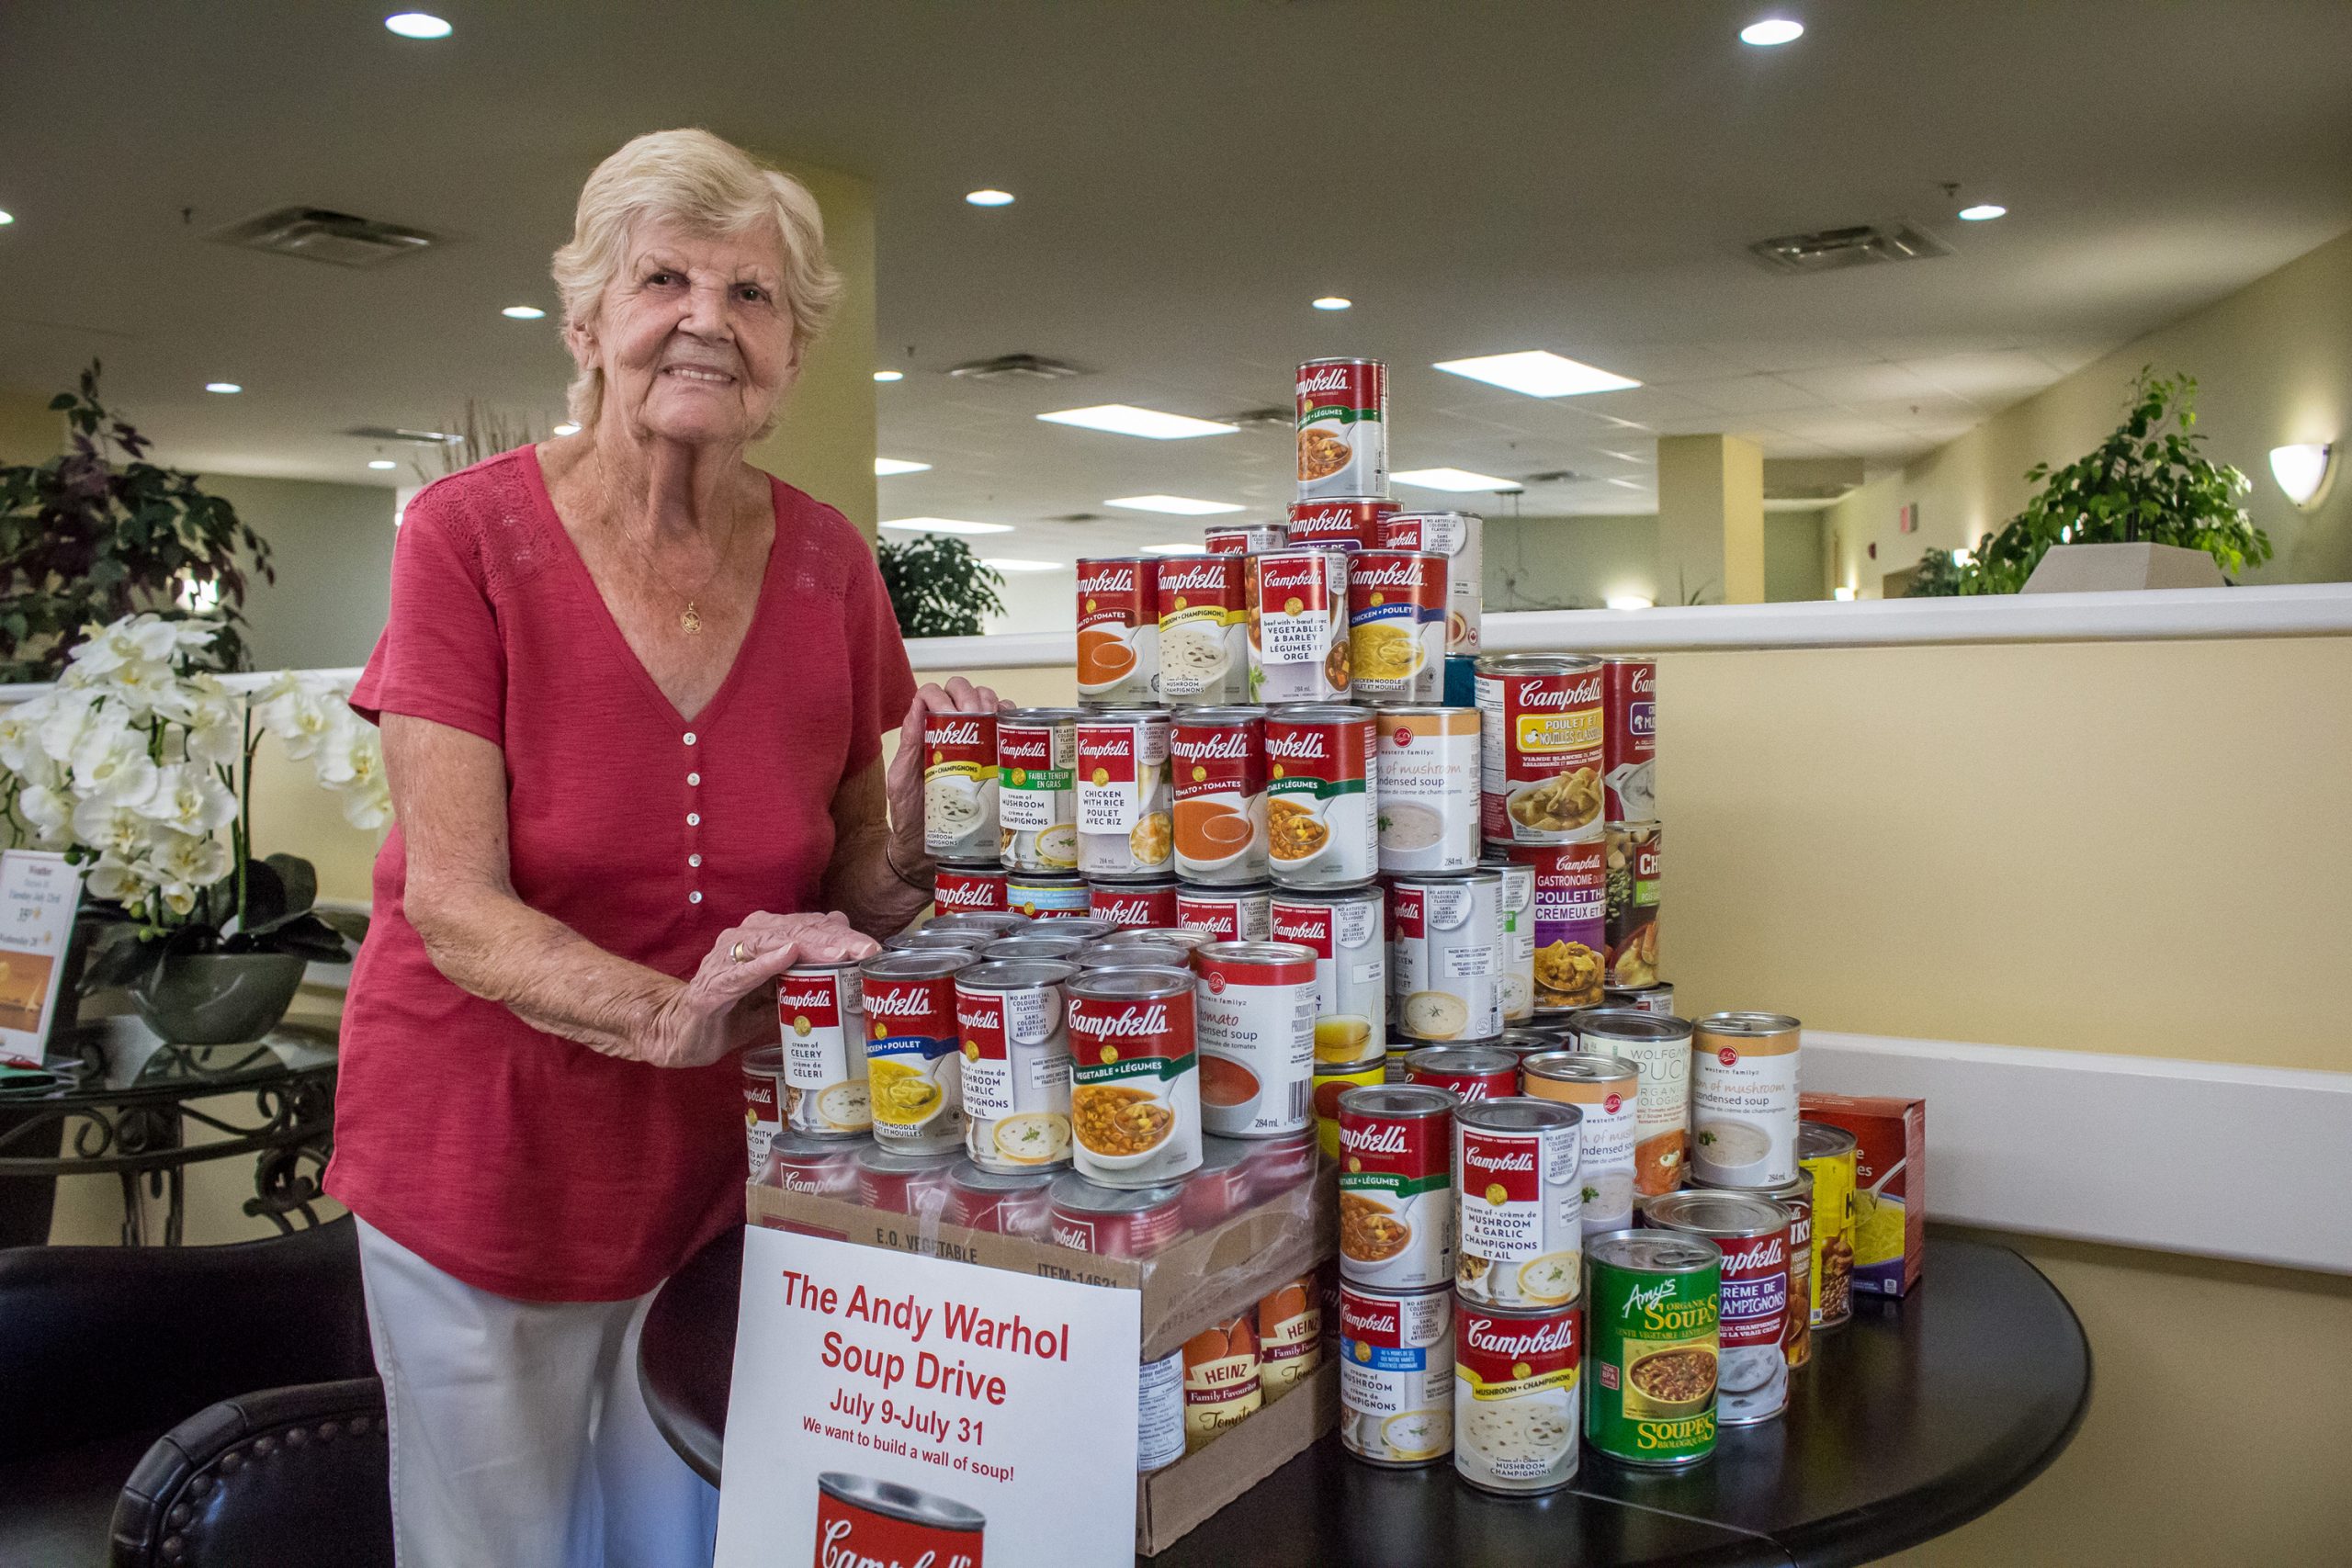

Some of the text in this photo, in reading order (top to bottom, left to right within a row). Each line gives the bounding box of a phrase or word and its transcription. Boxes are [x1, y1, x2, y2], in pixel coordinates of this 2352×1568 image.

[1314, 409, 1343, 419] LÉGUMES
[1078, 568, 1134, 596] ampbell's
[1264, 570, 1323, 589] Campbell's
[1093, 611, 1126, 620] TOMATES
[1182, 610, 1225, 620] CHAMPIGNONS
[1351, 606, 1413, 624] CHICKEN POULET
[1283, 634, 1317, 642] BARLEY
[1270, 643, 1312, 653] LÉGUMES
[1283, 652, 1309, 660] ORGE
[1520, 677, 1600, 710] Campbell's
[1545, 717, 1585, 730] POULET
[1079, 739, 1130, 760] Campbell's
[1385, 761, 1462, 775] of mushroom
[1175, 781, 1241, 796] TOMATO TOMATES
[1285, 781, 1317, 789] LÉGUMES
[1419, 778, 1445, 788] soup
[1085, 790, 1122, 798] CHICKEN
[1083, 798, 1102, 807] WITH
[1086, 818, 1122, 826] AVEC RIZ
[1538, 874, 1593, 887] GASTRONOMIE
[1536, 890, 1588, 904] POULET
[1536, 906, 1599, 920] CRÉMEUX ET
[1273, 918, 1327, 940] Campbell's
[1020, 992, 1050, 1000] ARTIFICIAL
[1012, 999, 1040, 1008] COLOURS
[1016, 1004, 1046, 1012] FLAVOURS
[1016, 1018, 1046, 1026] COLORANT
[1069, 999, 1168, 1042] Campbell's
[1199, 1011, 1238, 1027] tomato
[1015, 1029, 1049, 1038] ARTIFICIELS
[1026, 1024, 1046, 1032] SAVEUR
[1230, 1029, 1258, 1041] soup
[888, 1041, 921, 1050] POULET
[791, 1049, 822, 1059] CELERY
[793, 1067, 823, 1078] CÉLERI
[975, 1068, 996, 1077] crème
[1076, 1061, 1162, 1080] VEGETABLE LÉGUMES
[1704, 1066, 1730, 1075] western
[967, 1084, 995, 1097] GARLIC
[1710, 1078, 1786, 1094] of mushroom
[1744, 1096, 1770, 1106] soup
[974, 1108, 987, 1117] AIL
[1751, 1106, 1787, 1114] champignons
[1255, 1119, 1268, 1128] 284
[754, 1130, 772, 1138] WITH
[1593, 1131, 1605, 1144] of
[1581, 1141, 1624, 1156] ndensed
[1465, 1146, 1534, 1173] Campbell's
[1363, 1177, 1400, 1186] LÉGUMES
[1485, 1208, 1493, 1216] of
[1468, 1214, 1532, 1228] MUSHROOM
[876, 1227, 901, 1247] E.O.
[1474, 1225, 1523, 1239] & GARLIC
[1464, 1234, 1538, 1250] CHAMPIGNONS
[1494, 1250, 1511, 1259] AIL
[1722, 1237, 1782, 1277] mpbell's
[1763, 1281, 1776, 1293] DE
[1622, 1279, 1678, 1318] Amy's
[1721, 1291, 1785, 1314] AMPIGNONS
[782, 1270, 1069, 1362] The Andy Warhol
[1341, 1303, 1396, 1333] Campbell's
[1645, 1293, 1717, 1331] SOUPS
[1287, 1318, 1318, 1340] HEINZ
[1467, 1319, 1573, 1359] Campbell's
[1274, 1345, 1301, 1358] Family
[821, 1331, 1007, 1406] Soup Drive
[1204, 1363, 1249, 1385] HEINZ
[1343, 1371, 1393, 1392] MUSHROOM
[1602, 1370, 1615, 1381] BPA
[1476, 1374, 1571, 1396] MUSHROOM CHAMPIGNONS
[1191, 1382, 1257, 1402] Family Favourites
[830, 1388, 984, 1447] July 9-July 31
[1637, 1412, 1715, 1450] SOUPES
[803, 1416, 1015, 1483] We want to build a wall of soup!
[1490, 1469, 1552, 1477] CHAMPIGNONS
